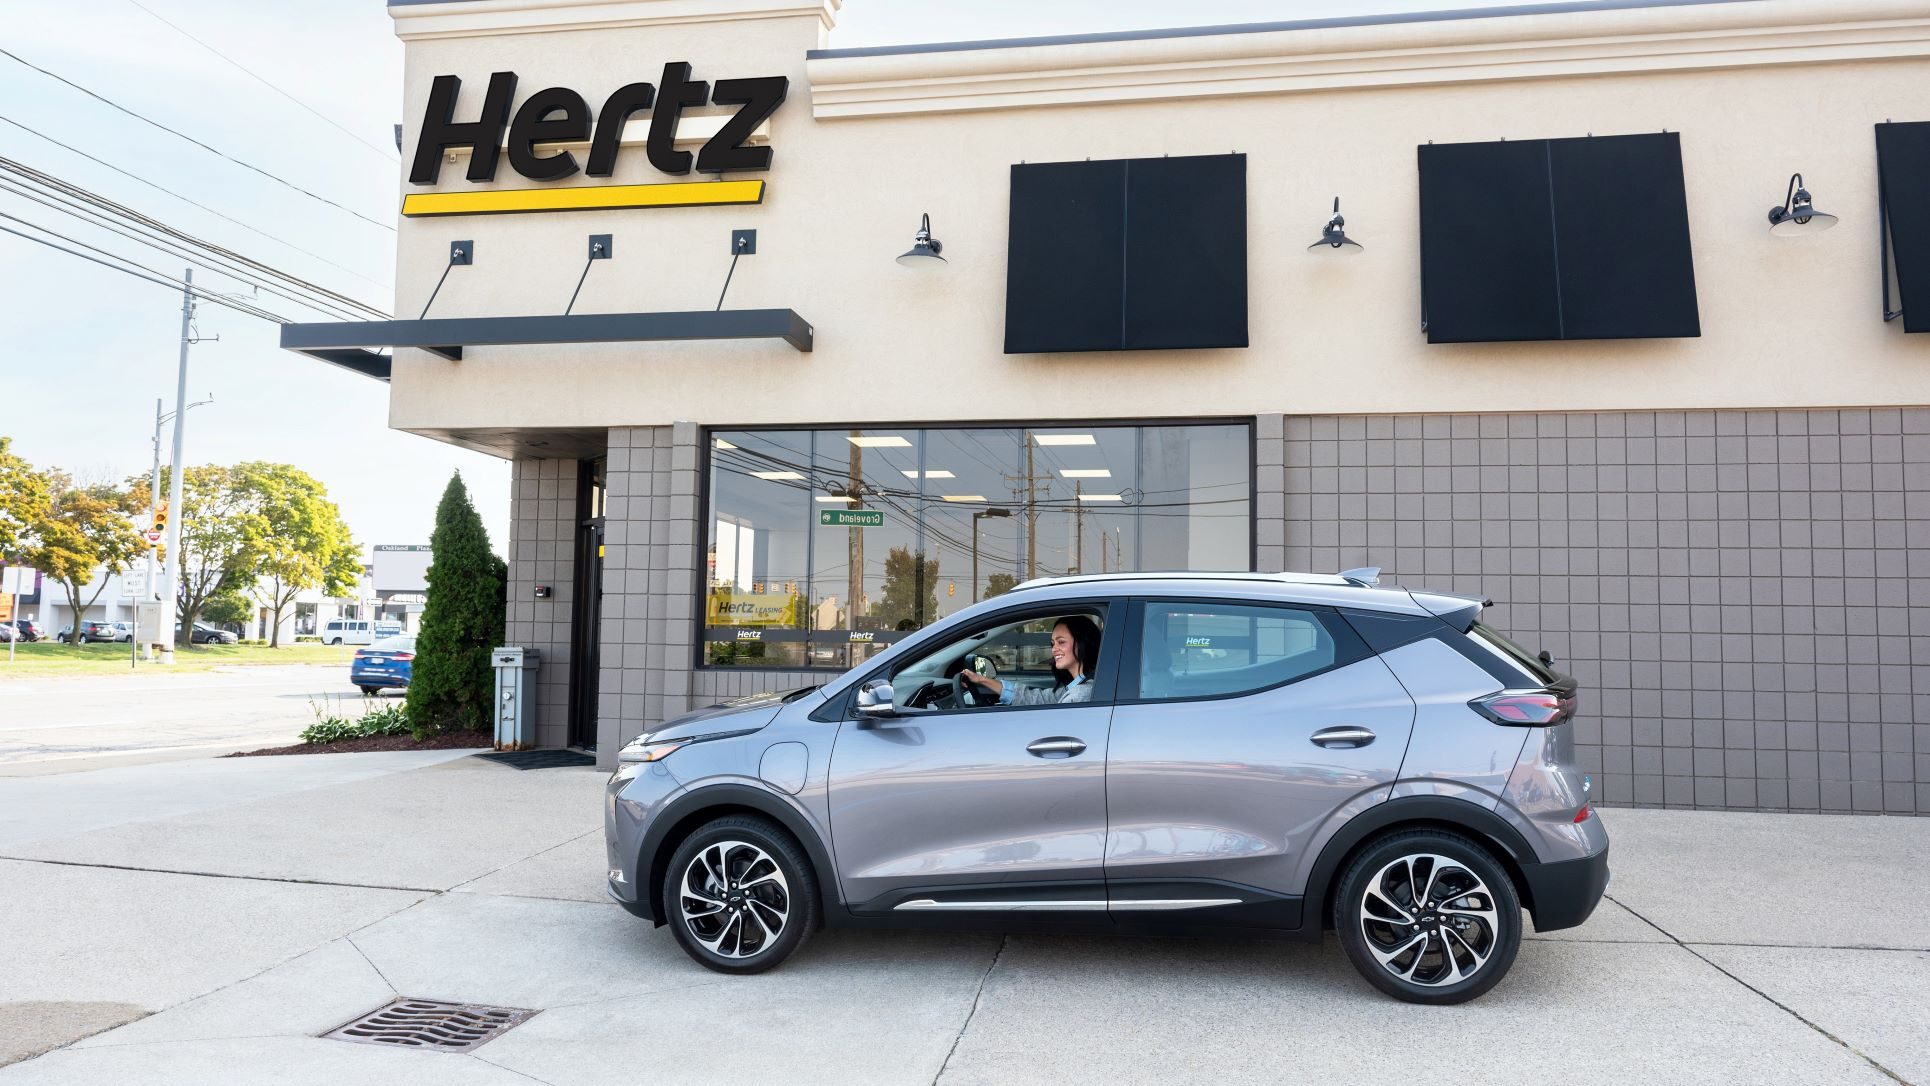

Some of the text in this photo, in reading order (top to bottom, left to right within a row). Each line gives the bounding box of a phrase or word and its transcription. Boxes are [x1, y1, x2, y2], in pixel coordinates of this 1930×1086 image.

[408, 61, 790, 184] Hertz
[718, 601, 755, 614] Hertz
[737, 630, 762, 639] Hertz
[850, 631, 875, 640] Hertz
[1186, 637, 1210, 645] Hertz
